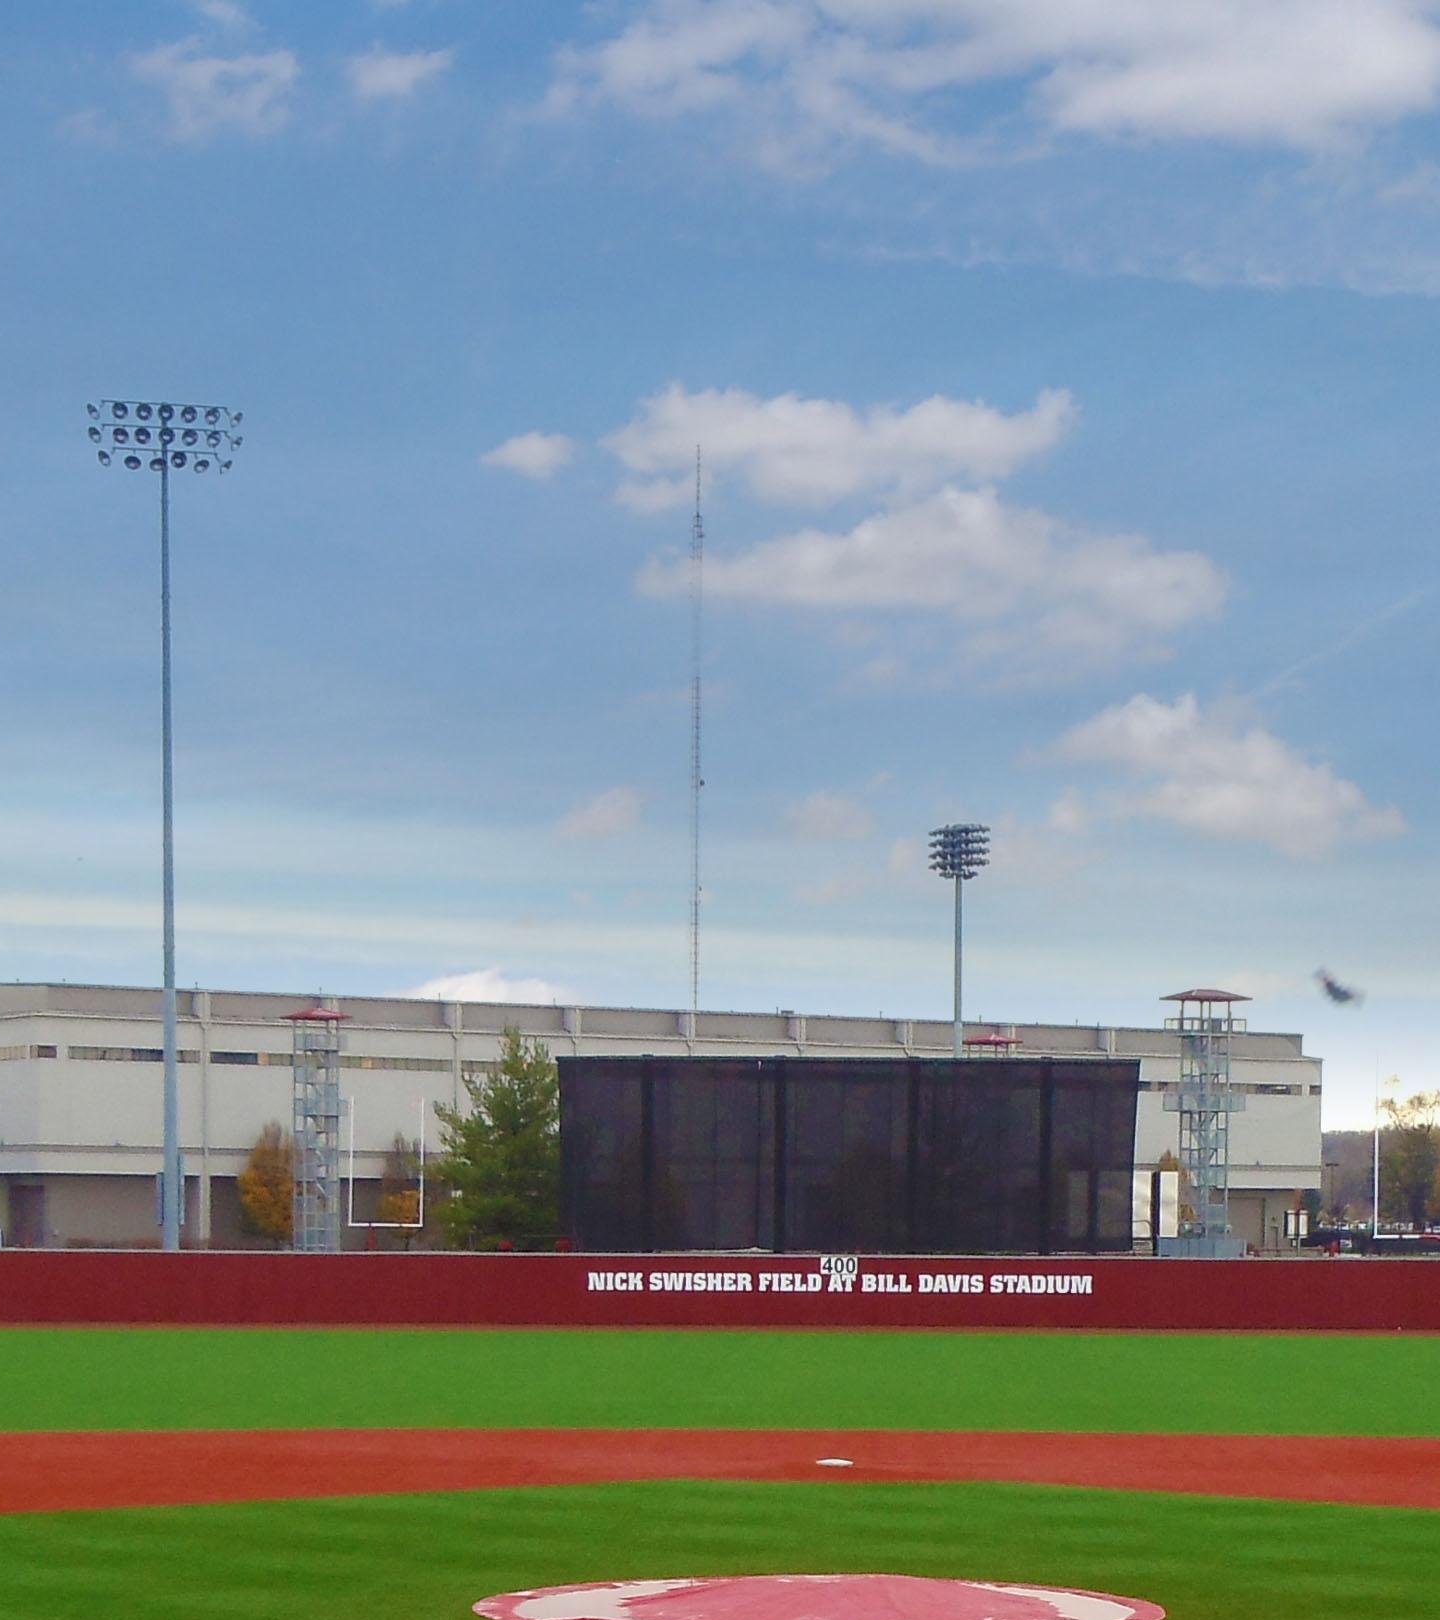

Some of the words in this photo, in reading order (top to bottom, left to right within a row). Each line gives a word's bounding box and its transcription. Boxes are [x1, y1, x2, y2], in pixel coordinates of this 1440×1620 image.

[822, 1257, 856, 1274] 400
[587, 1272, 644, 1291] NICK
[648, 1272, 753, 1292] SWISHER
[758, 1273, 823, 1292] FIELD
[827, 1273, 857, 1292] AT
[861, 1274, 912, 1293] BILL
[918, 1274, 985, 1293] DAVIS
[989, 1274, 1093, 1294] STADIUM
